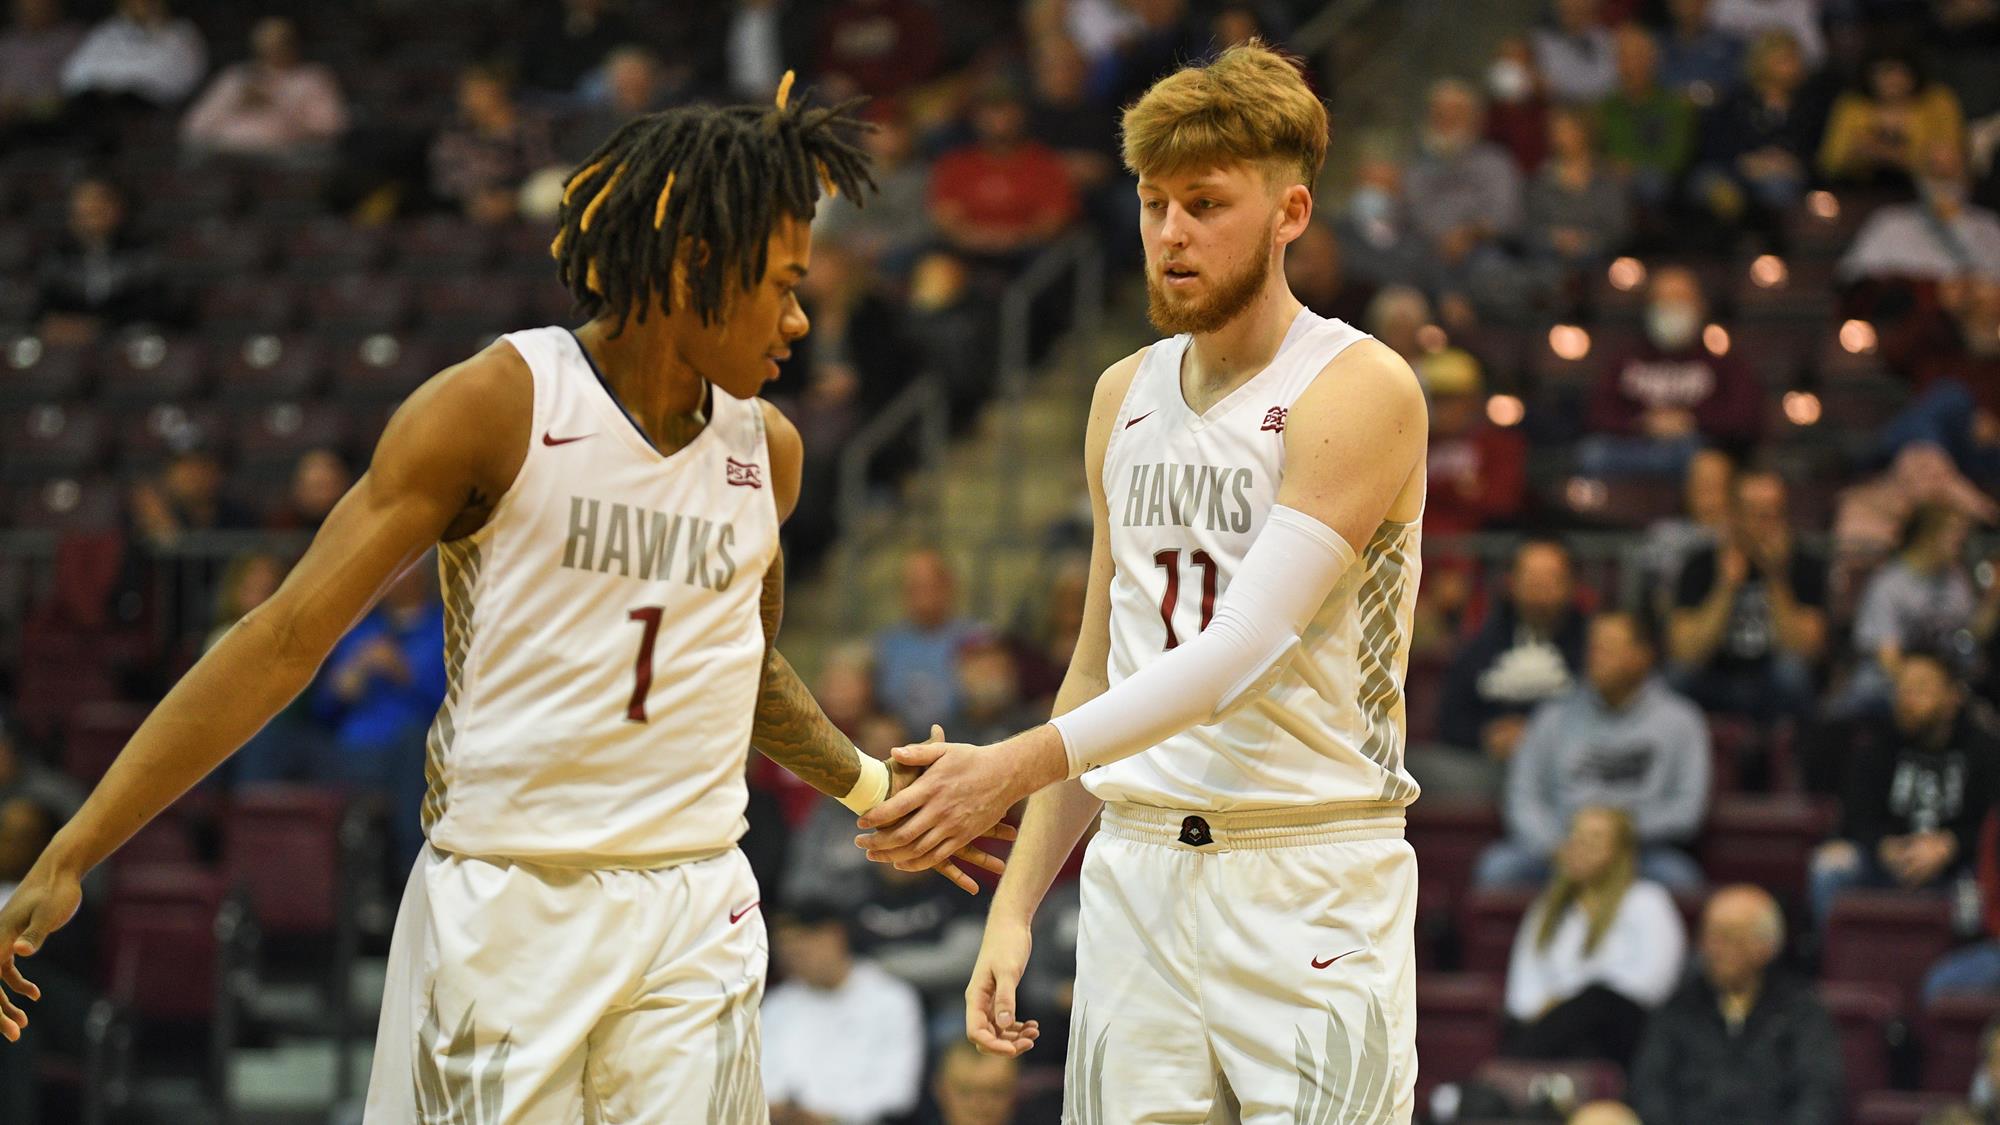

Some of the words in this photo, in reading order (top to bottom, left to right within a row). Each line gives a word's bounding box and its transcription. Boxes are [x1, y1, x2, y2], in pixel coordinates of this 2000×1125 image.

[561, 496, 736, 593] HAWKS
[1123, 463, 1253, 534] HAWKS
[1153, 547, 1219, 653] 11
[624, 605, 666, 724] 1
